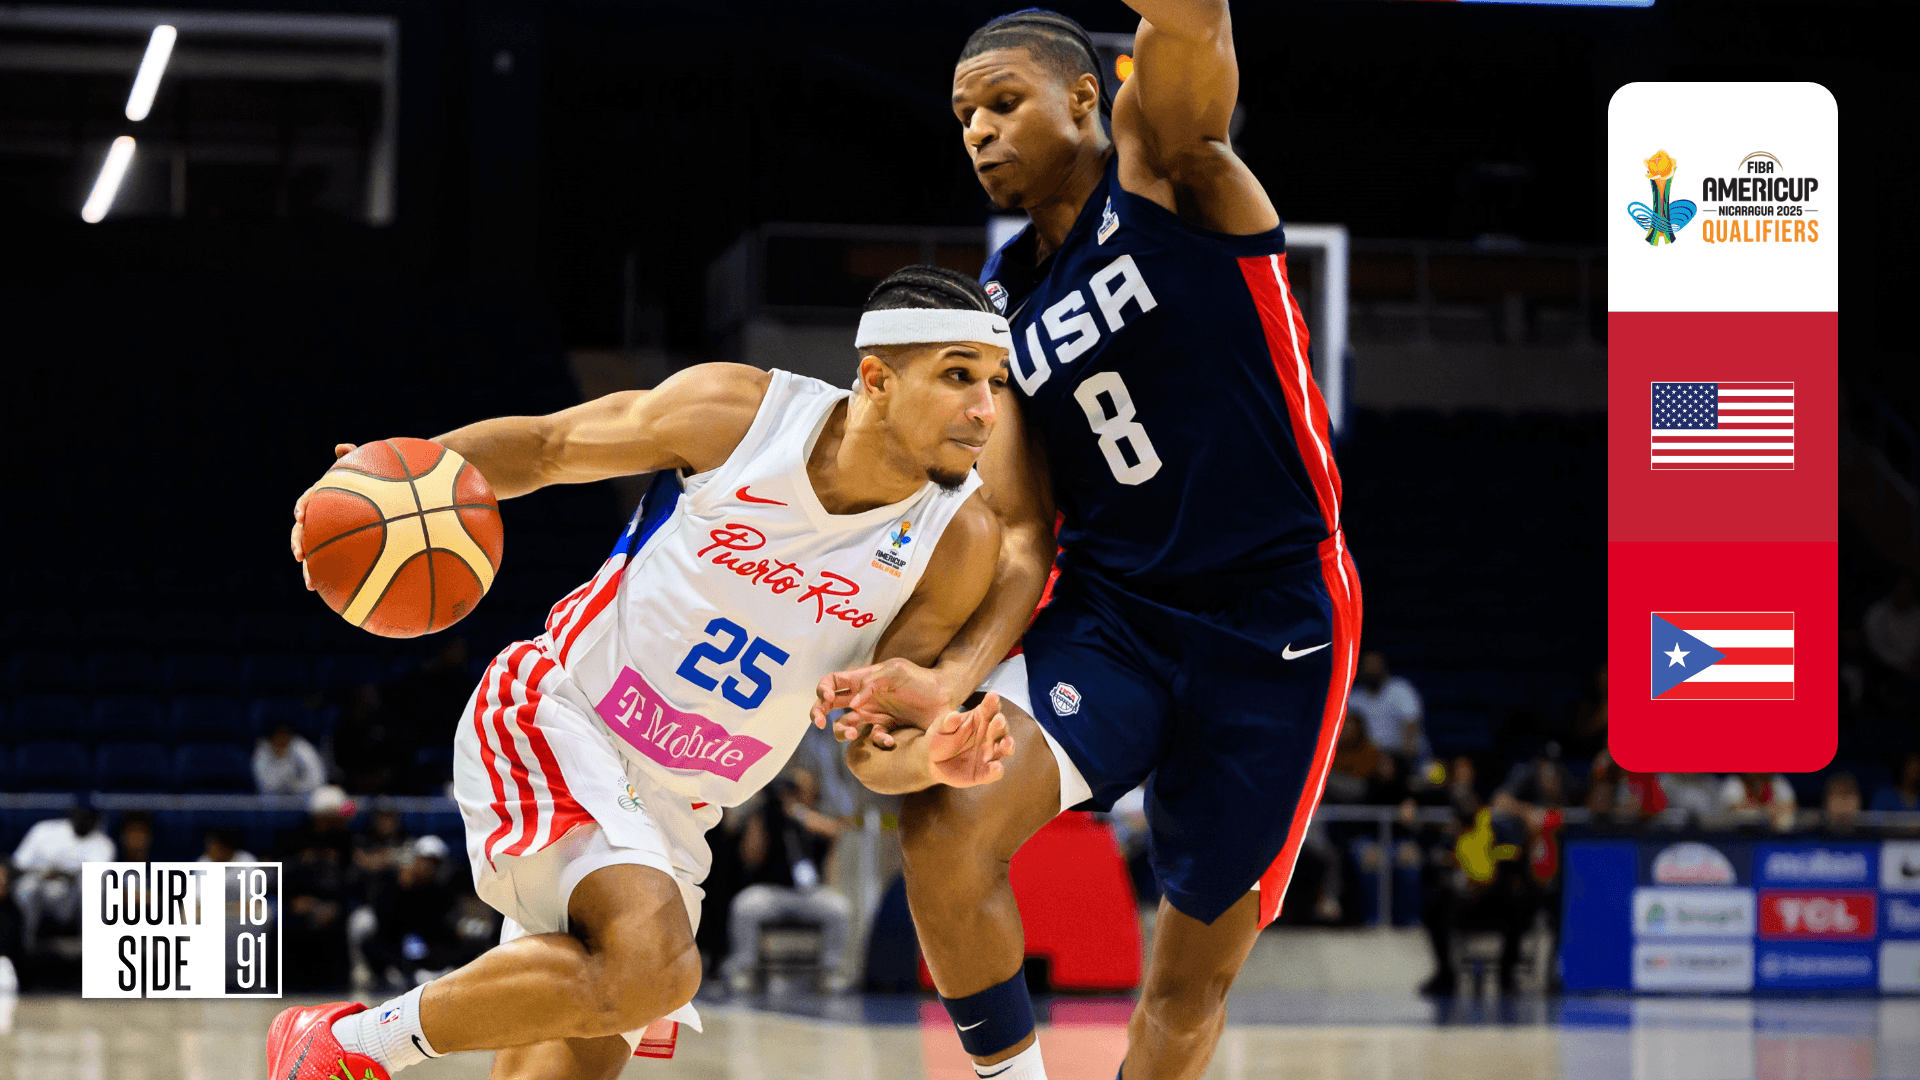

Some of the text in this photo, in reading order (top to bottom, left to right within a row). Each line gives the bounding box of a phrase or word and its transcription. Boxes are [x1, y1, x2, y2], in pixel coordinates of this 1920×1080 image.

[1009, 254, 1158, 397] USA
[1073, 371, 1163, 486] 8
[697, 523, 878, 629] Puerto Rico
[875, 550, 907, 567] AMERICUP
[675, 617, 790, 710] 25
[1779, 897, 1859, 933] TCL
